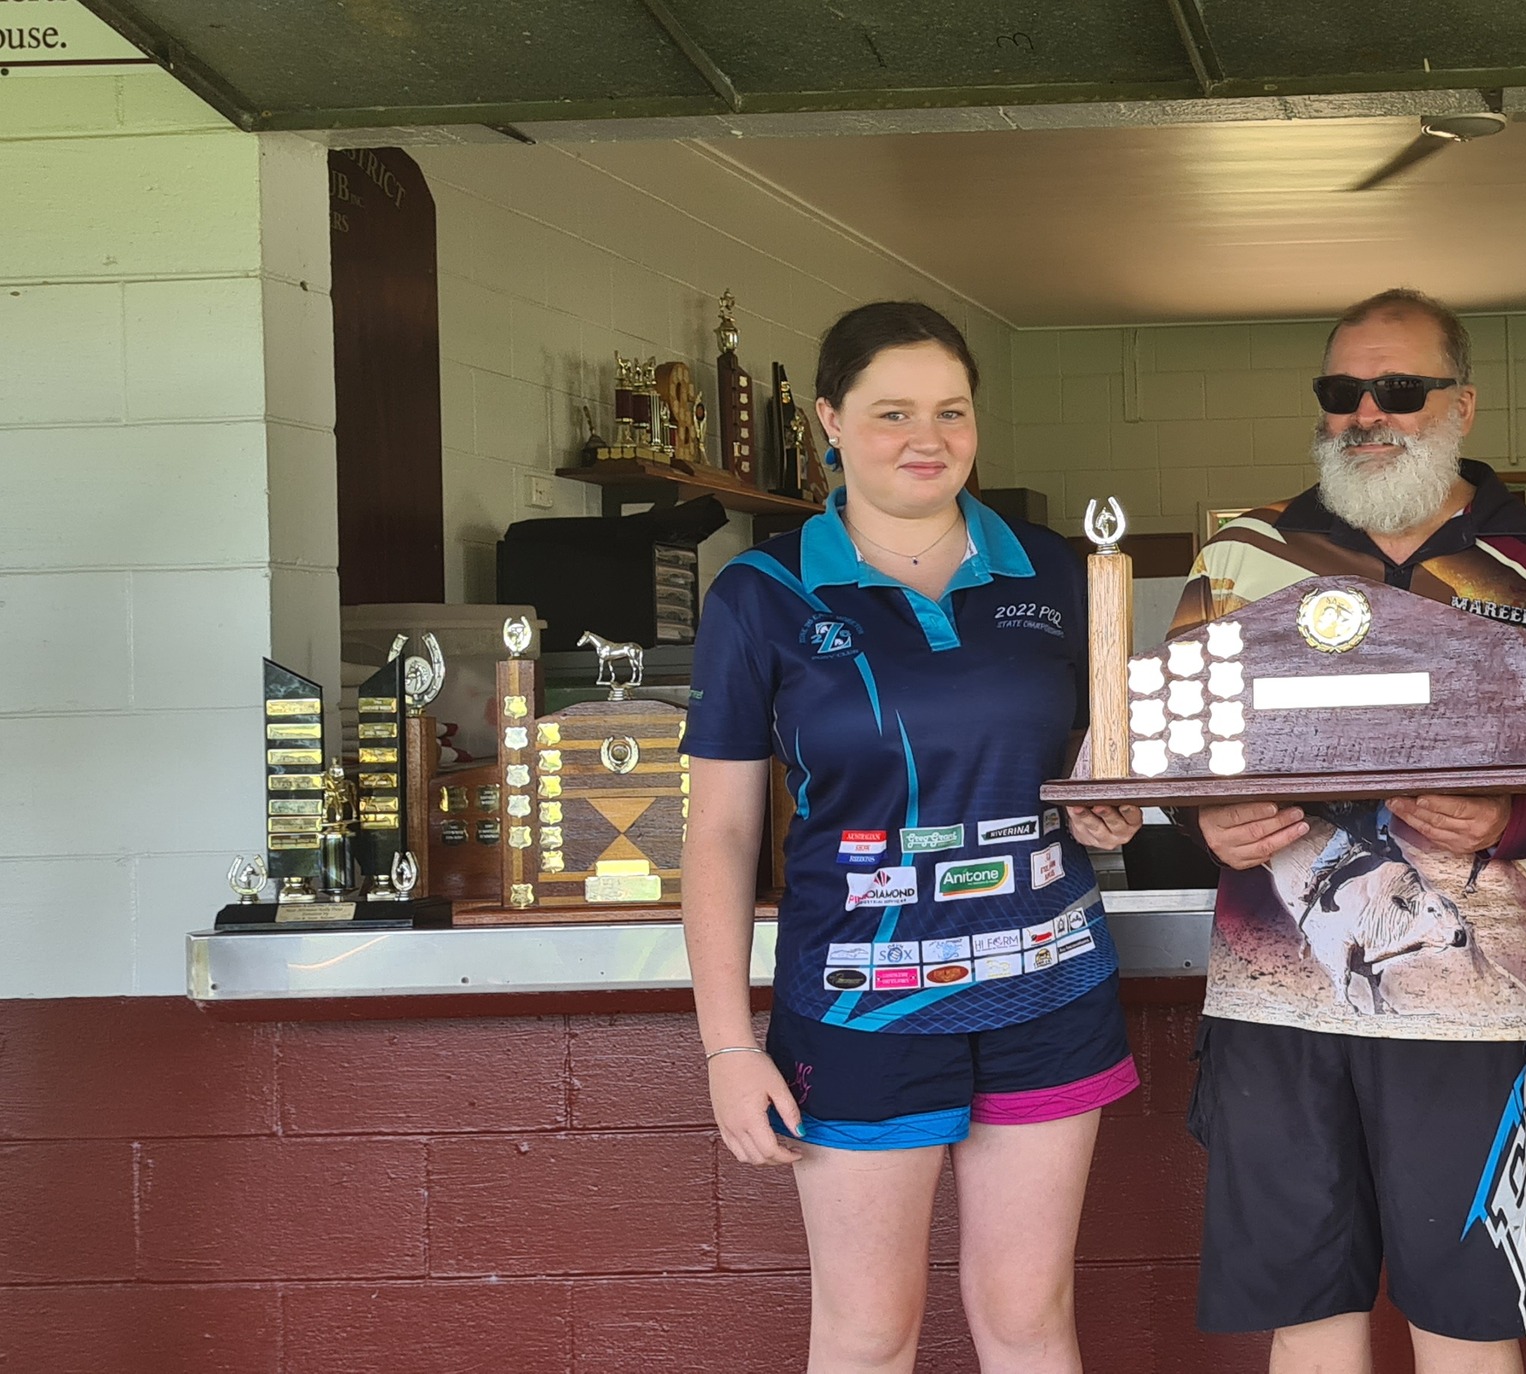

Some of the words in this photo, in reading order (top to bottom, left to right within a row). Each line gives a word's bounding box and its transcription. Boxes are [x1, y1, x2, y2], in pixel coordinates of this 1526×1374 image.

[995, 603, 1037, 619] 2022
[1038, 606, 1063, 629] PCQ
[943, 868, 999, 885] Anitone
